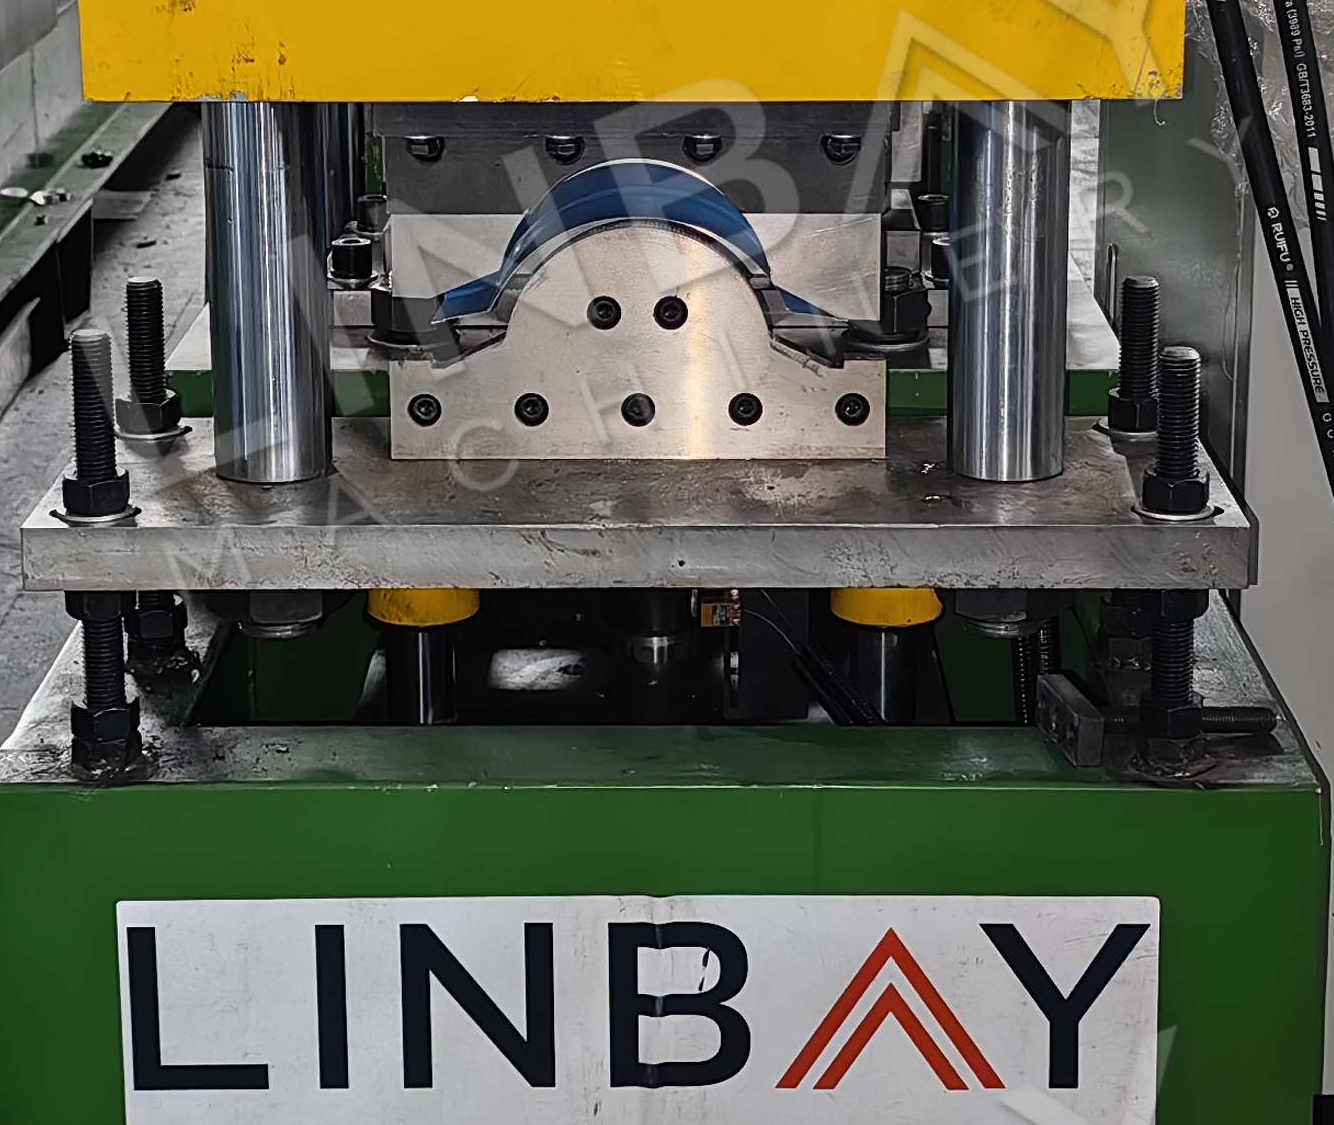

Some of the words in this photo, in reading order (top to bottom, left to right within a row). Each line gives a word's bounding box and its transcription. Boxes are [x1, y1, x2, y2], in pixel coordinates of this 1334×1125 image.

[1295, 63, 1318, 138] GB/T3683-2011
[1291, 296, 1305, 325] HIGH
[1300, 329, 1324, 394] PRESSURE
[126, 922, 1150, 1091] LINBAY
